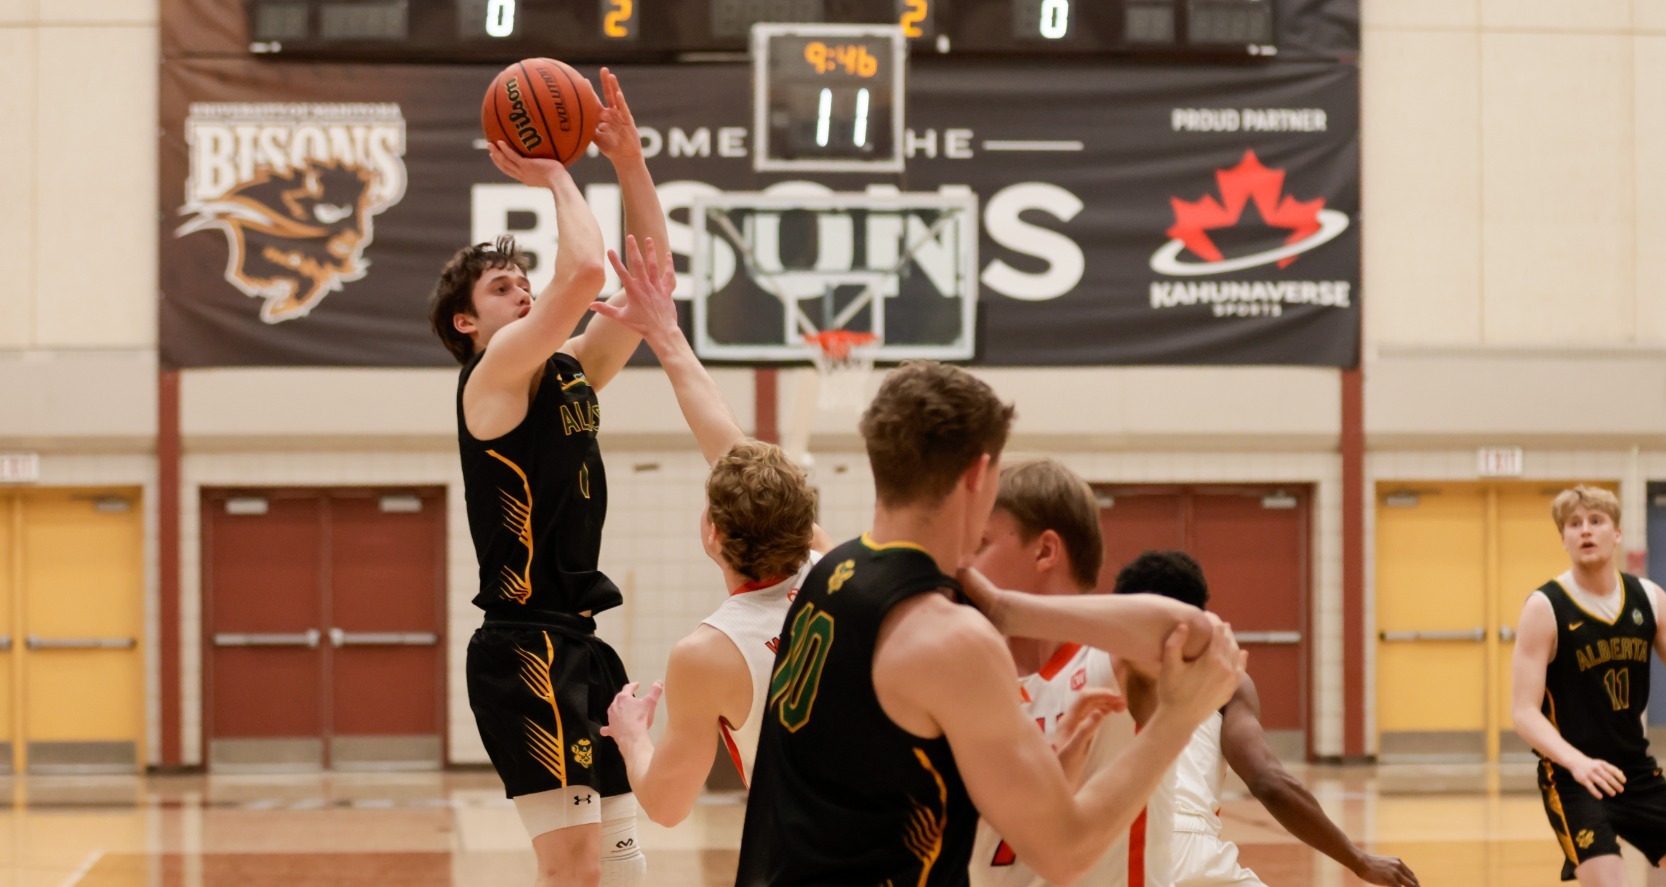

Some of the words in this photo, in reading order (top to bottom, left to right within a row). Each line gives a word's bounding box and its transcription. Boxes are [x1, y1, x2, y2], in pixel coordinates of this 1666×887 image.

[485, 0, 515, 37] 0
[603, 0, 633, 38] 2
[901, 0, 928, 38] 2
[1039, 0, 1069, 39] 0
[804, 41, 878, 78] 9:46
[505, 76, 543, 152] Wilson
[816, 87, 870, 148] 11
[1171, 108, 1240, 132] PROUD
[1242, 108, 1328, 132] PARTNER
[193, 121, 404, 202] BISONS
[904, 128, 974, 158] HE
[470, 180, 1086, 302] BISONS
[1150, 281, 1350, 308] KAHUNAVERSE
[1575, 637, 1649, 672] ALBERTA
[1603, 666, 1630, 712] 11
